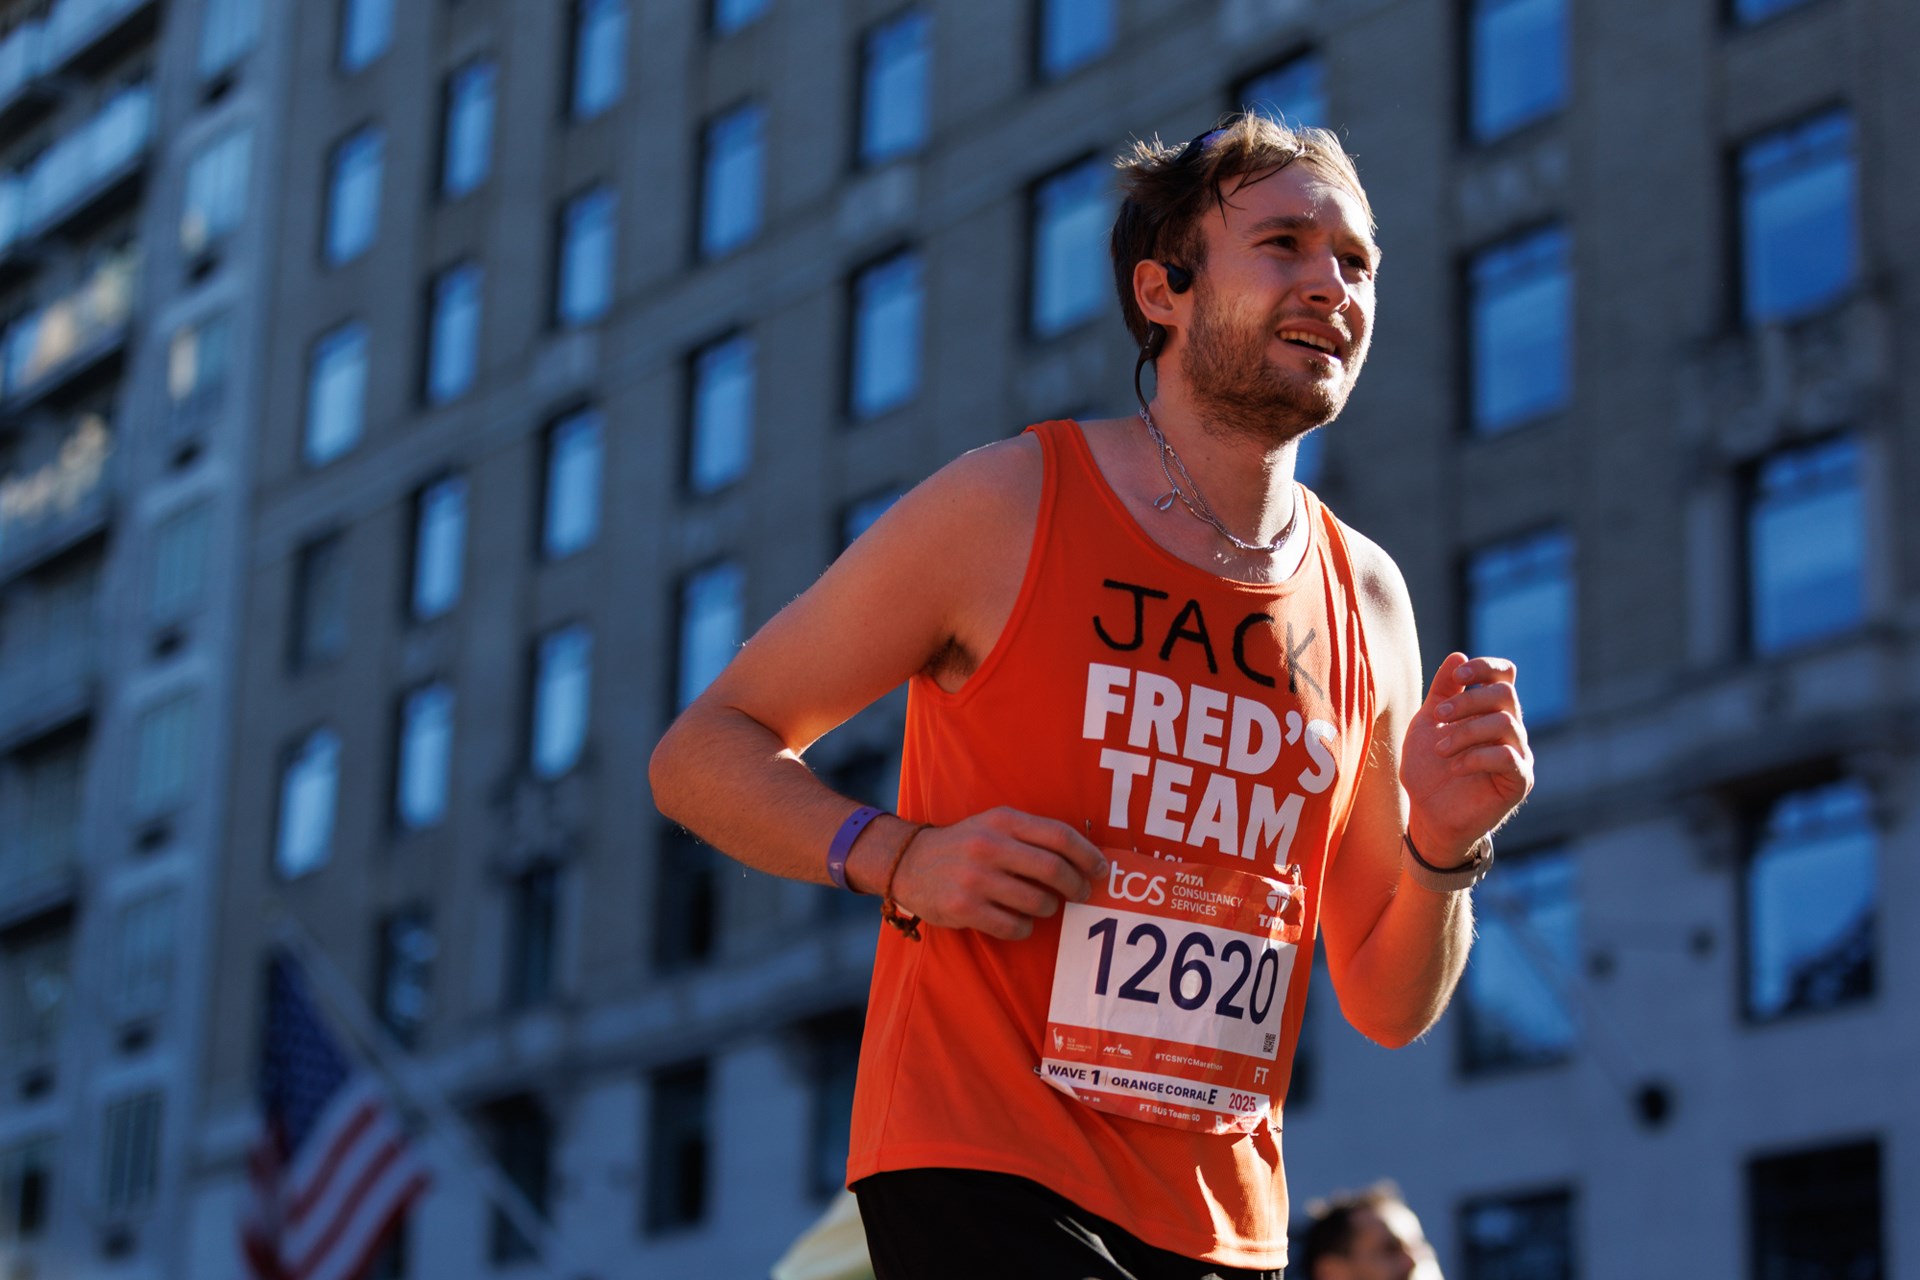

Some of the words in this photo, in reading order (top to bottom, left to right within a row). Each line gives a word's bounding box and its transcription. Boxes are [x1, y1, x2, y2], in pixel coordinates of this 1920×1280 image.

[1093, 579, 1325, 700] JACK
[1082, 662, 1339, 795] FRED'S
[1099, 748, 1306, 873] TEAM
[1108, 861, 1167, 906] tcs
[1175, 872, 1204, 888] TATA
[1171, 898, 1217, 916] SERVICES
[1172, 885, 1243, 908] CONSULTANCY
[1088, 917, 1279, 1025] 12620
[1155, 1053, 1223, 1071] #TCSNYCMarathon
[1047, 1064, 1087, 1080] WAVE
[1091, 1070, 1101, 1086] 1
[1111, 1076, 1164, 1094] ORANGE
[1165, 1084, 1207, 1102] CORRAL
[1207, 1088, 1218, 1105] E
[1253, 1066, 1270, 1085] FT
[1139, 1103, 1151, 1113] FT
[1152, 1106, 1167, 1117] BUS
[1228, 1092, 1257, 1112] 2025
